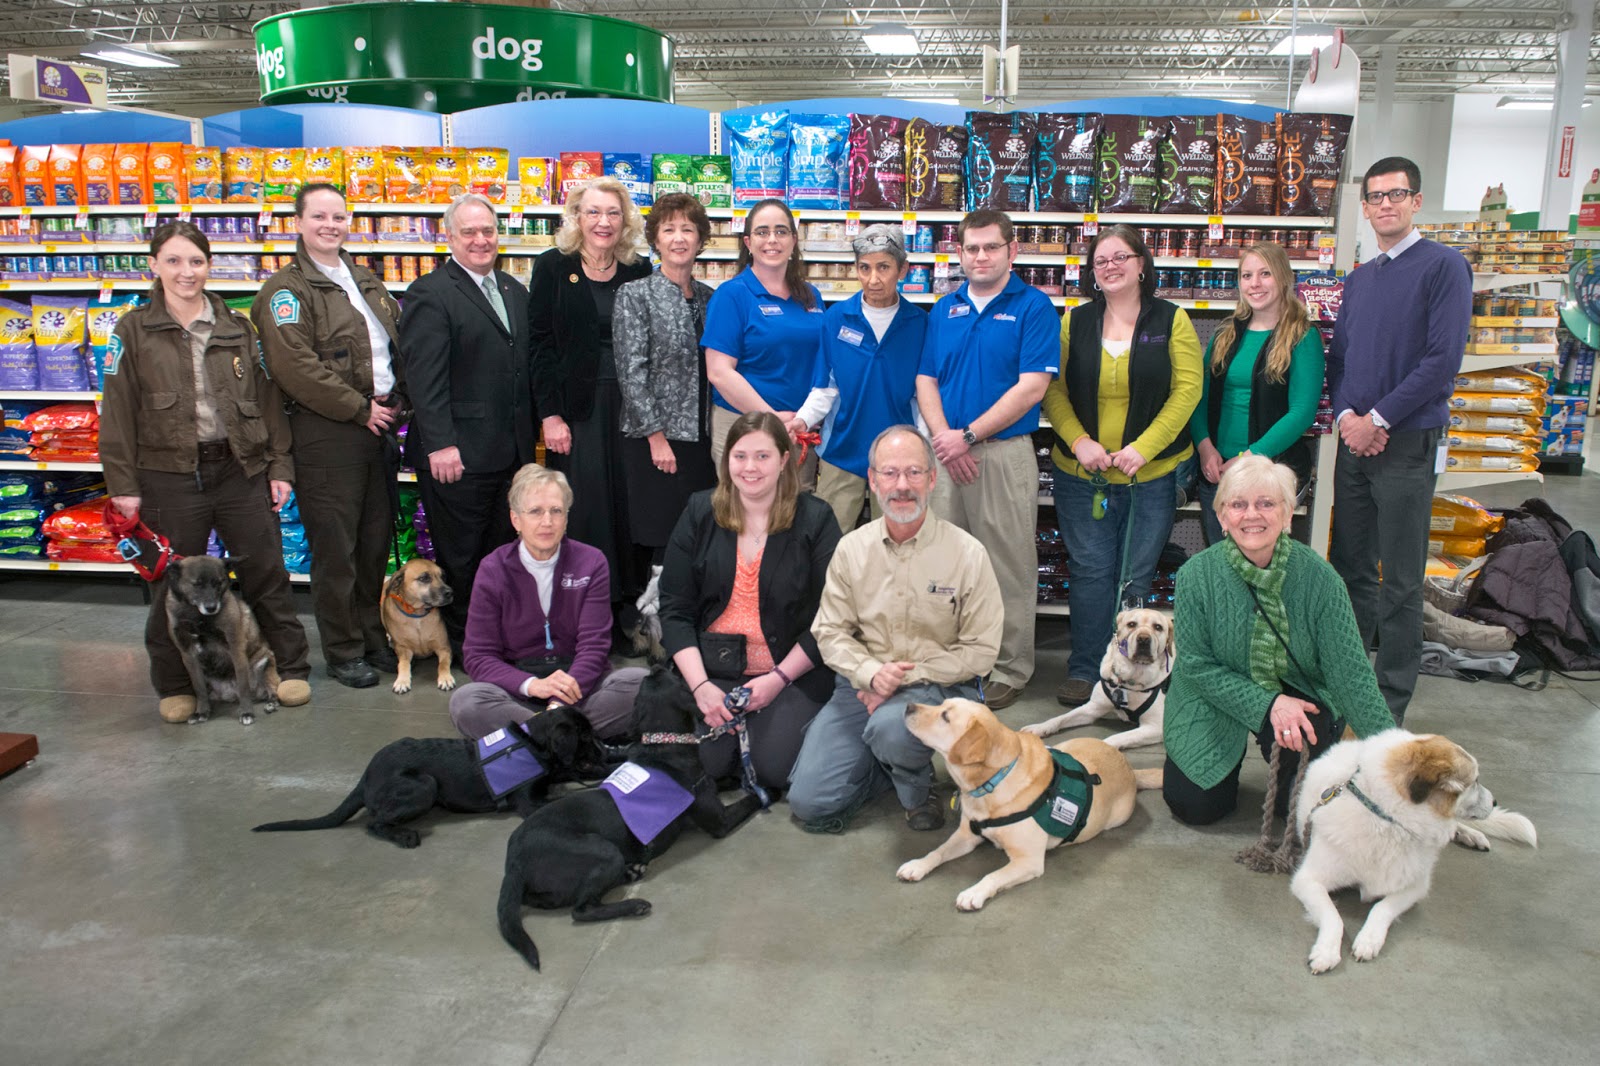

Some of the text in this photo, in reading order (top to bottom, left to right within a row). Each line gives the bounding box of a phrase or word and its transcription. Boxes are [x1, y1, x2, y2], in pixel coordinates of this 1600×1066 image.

[472, 26, 543, 71] dog
[260, 43, 286, 79] dog
[40, 84, 69, 97] WELLNESS
[734, 151, 782, 171] Simple
[909, 128, 929, 197] CORE
[1038, 133, 1057, 199] CORE
[1099, 131, 1120, 200] CORE
[1222, 131, 1244, 200] CORE
[1248, 152, 1275, 160] WELLN
[149, 167, 177, 175] WELLNESS
[1160, 140, 1178, 200] CORE
[1280, 131, 1304, 203] CORE
[656, 182, 680, 190] pure
[697, 174, 727, 182] WELLNESS
[697, 183, 724, 191] pure
[1304, 288, 1341, 297] Original
[1308, 295, 1337, 304] Recipe
